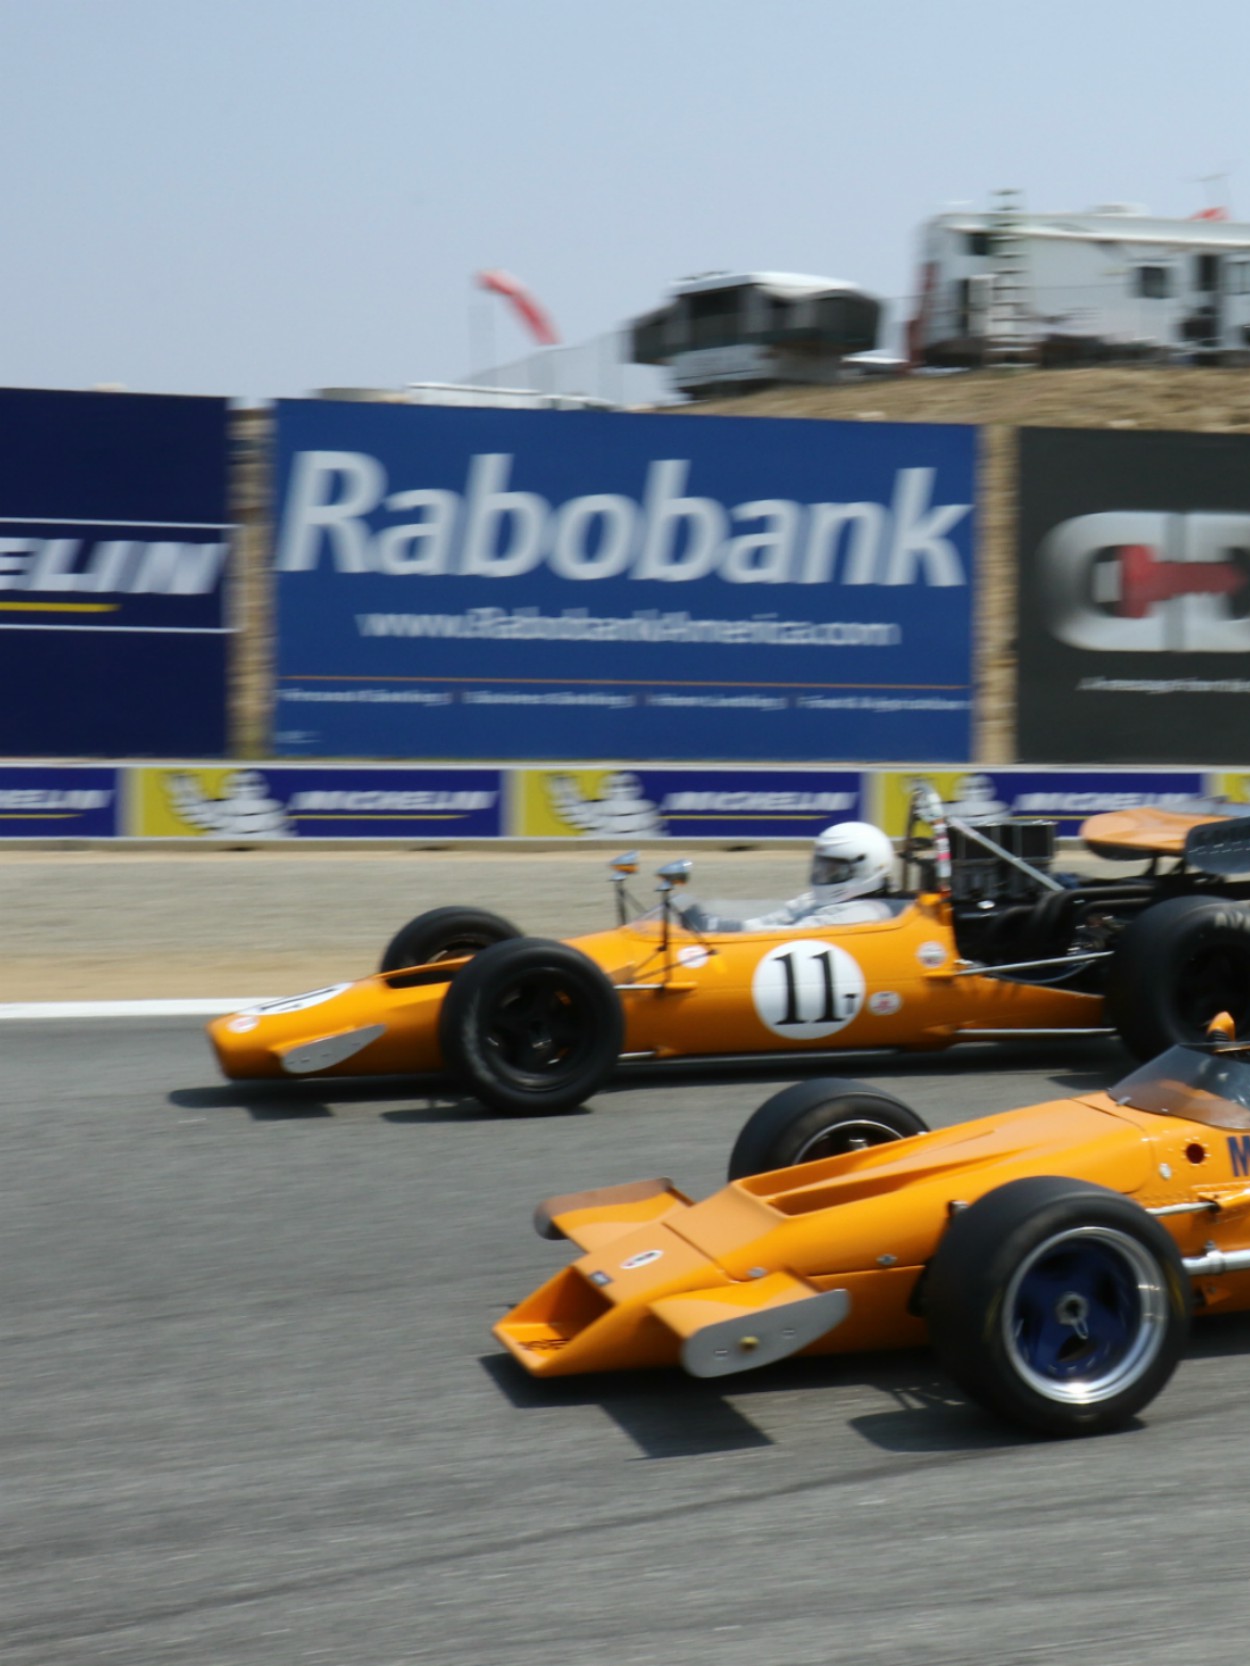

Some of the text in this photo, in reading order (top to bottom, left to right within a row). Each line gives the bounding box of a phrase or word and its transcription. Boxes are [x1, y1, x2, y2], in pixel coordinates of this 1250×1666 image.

[275, 450, 974, 588] Rabobank
[289, 790, 499, 811] MICHELIN
[661, 791, 860, 811] MICHELIN
[773, 950, 846, 1026] 11
